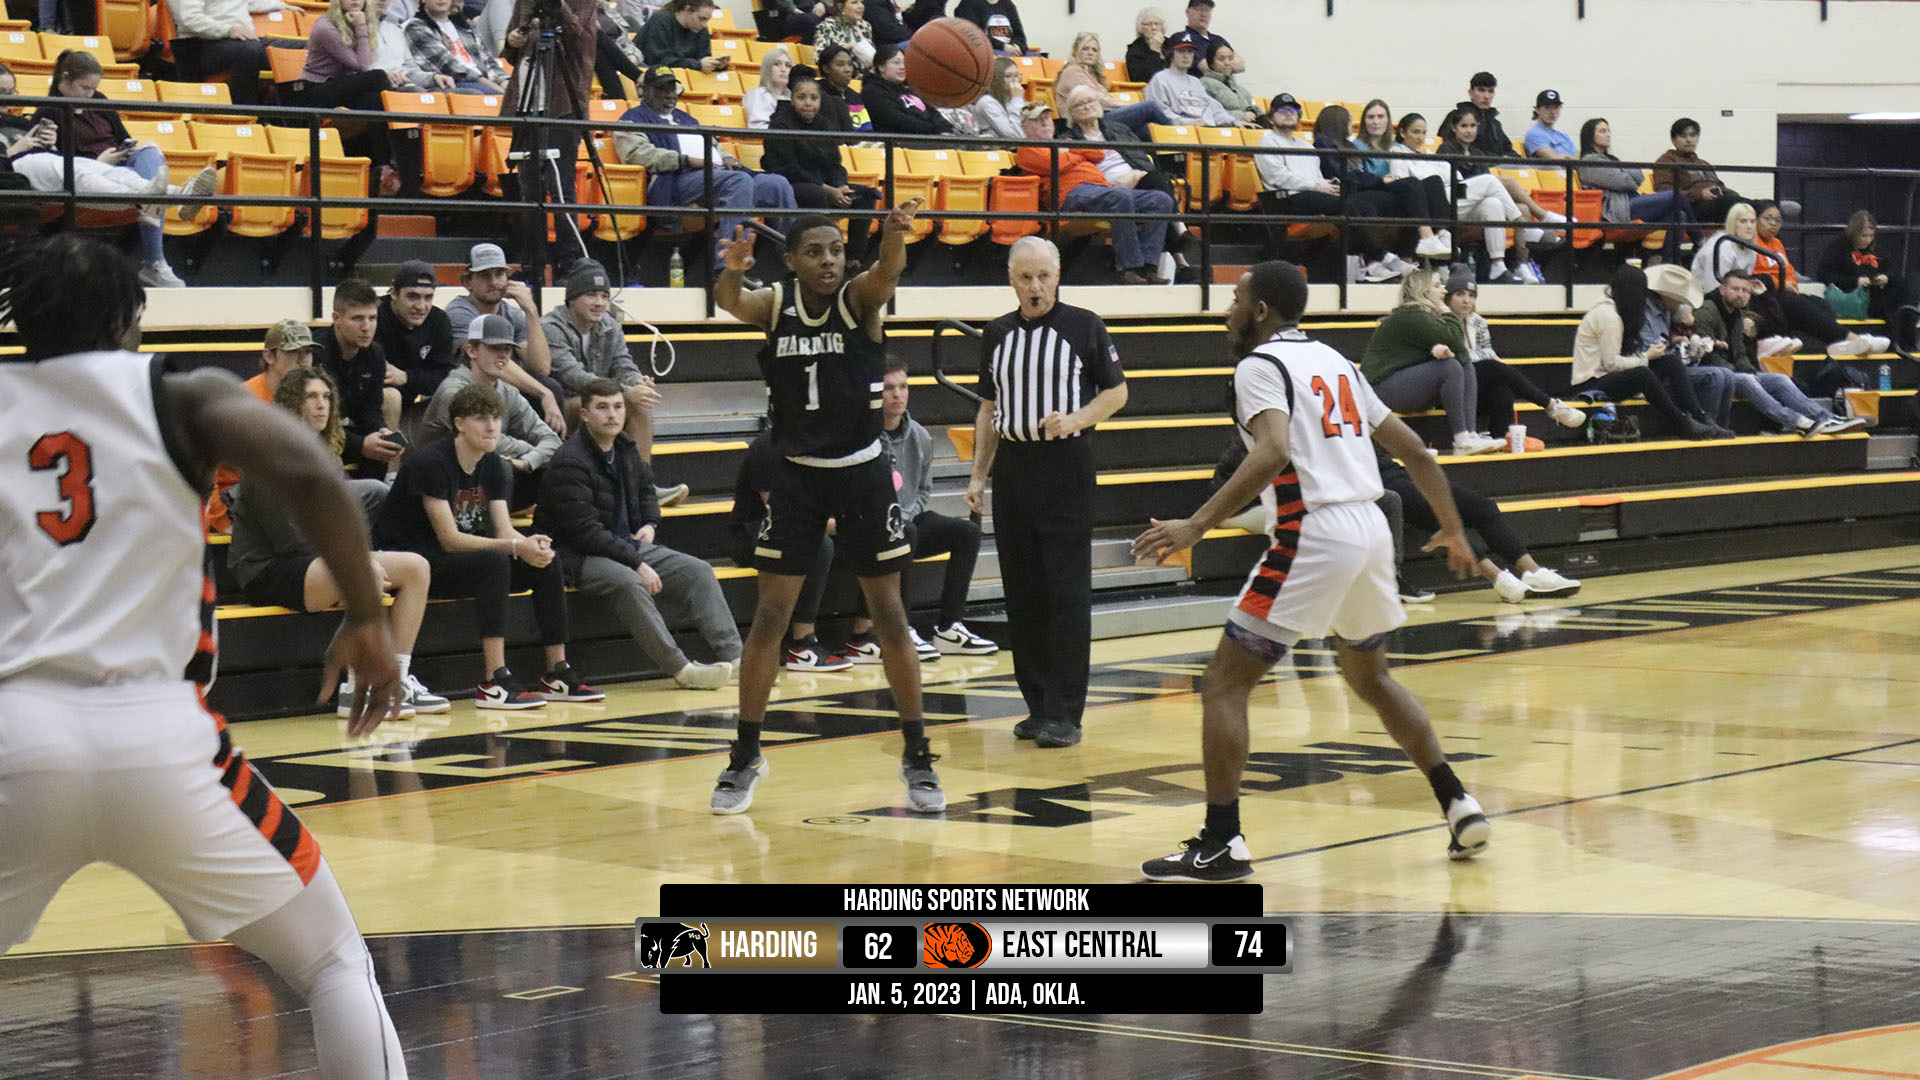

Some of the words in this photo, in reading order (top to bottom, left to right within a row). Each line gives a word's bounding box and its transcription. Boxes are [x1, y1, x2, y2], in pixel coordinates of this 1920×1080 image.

[1181, 33, 1193, 43] A
[776, 332, 845, 358] HARDNG
[804, 361, 821, 411] 1
[1310, 373, 1363, 438] 24
[28, 430, 97, 547] 3
[268, 644, 1495, 806] ENTRAL
